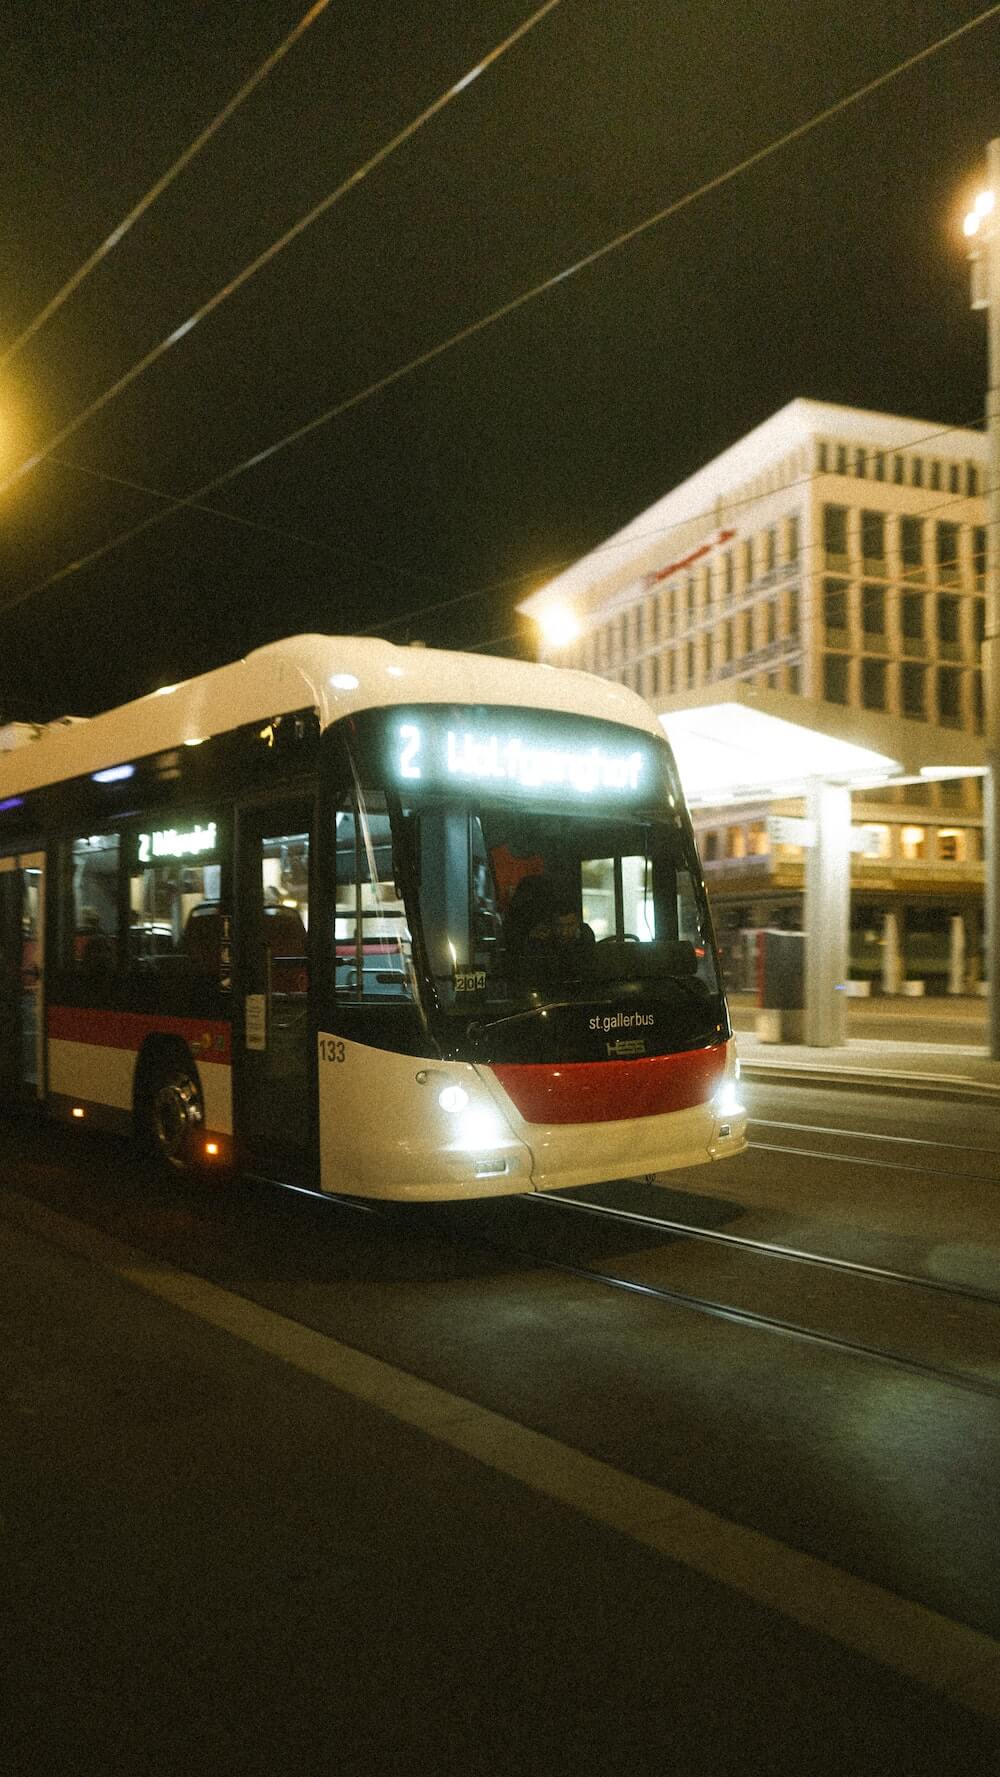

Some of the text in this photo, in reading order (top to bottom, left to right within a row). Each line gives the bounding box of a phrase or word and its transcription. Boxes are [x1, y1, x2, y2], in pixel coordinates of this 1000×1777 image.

[399, 724, 421, 778] 2
[138, 833, 150, 862] 2
[456, 975, 485, 990] 204
[589, 1011, 654, 1032] st.gallerbus
[319, 1040, 346, 1062] 133
